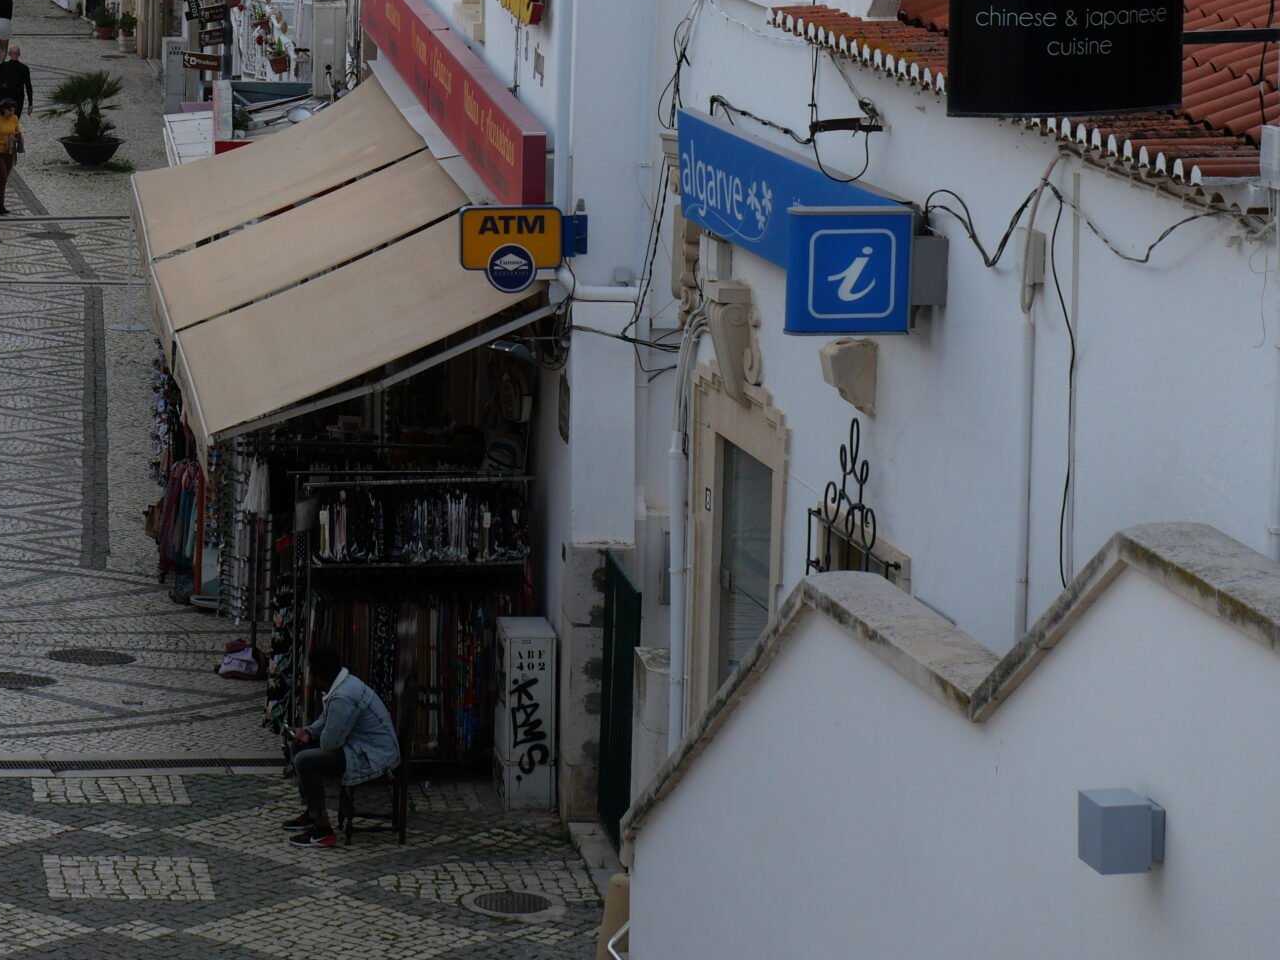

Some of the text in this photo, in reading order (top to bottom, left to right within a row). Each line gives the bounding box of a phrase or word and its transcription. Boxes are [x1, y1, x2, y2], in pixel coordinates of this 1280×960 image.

[975, 5, 1167, 30] chinese & japanese
[1047, 37, 1113, 56] cuisine
[682, 139, 744, 220] algarve
[478, 215, 545, 235] ATM
